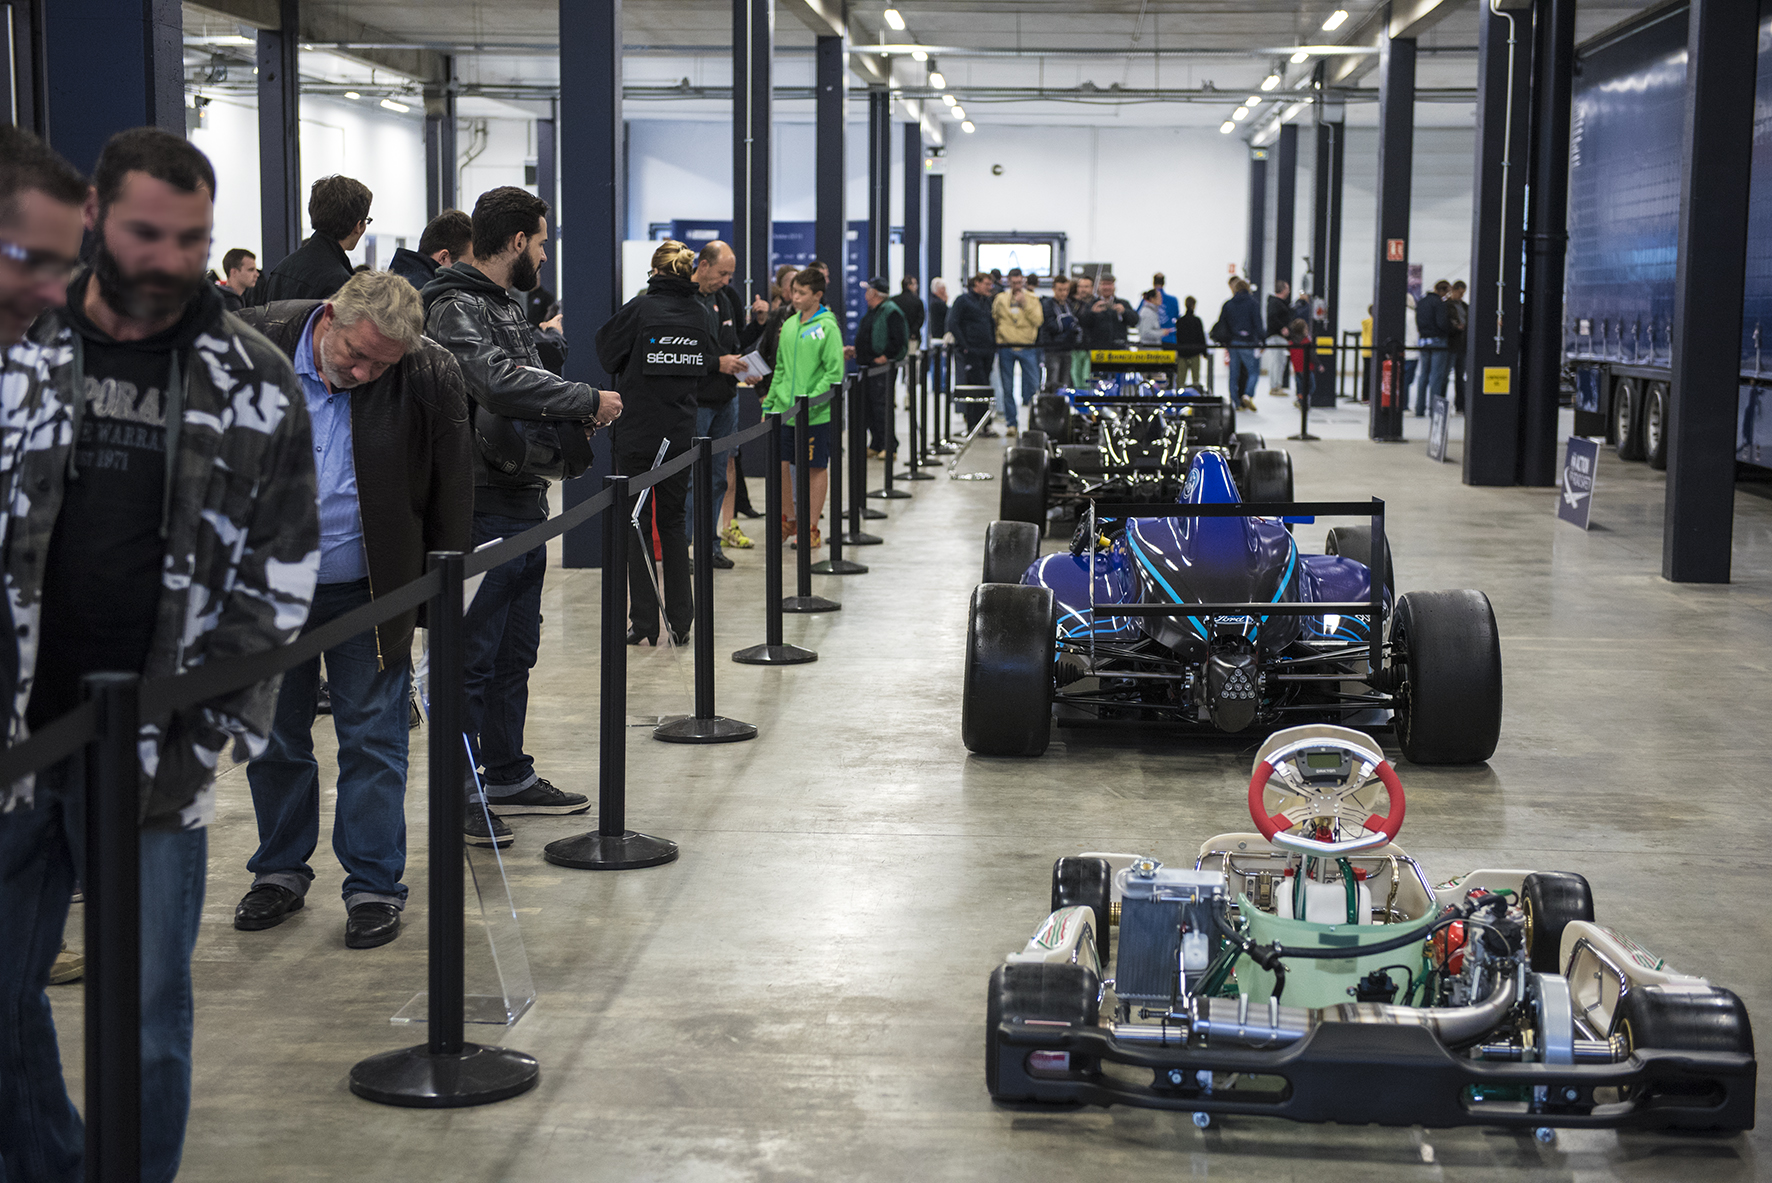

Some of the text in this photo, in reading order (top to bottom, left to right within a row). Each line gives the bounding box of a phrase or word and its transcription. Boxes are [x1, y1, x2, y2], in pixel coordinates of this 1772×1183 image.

[658, 336, 698, 346] Elite
[647, 350, 704, 366] SÉCURITÉ
[83, 376, 167, 427] PORA
[98, 423, 167, 452] WARRA
[1214, 615, 1245, 623] Ford
